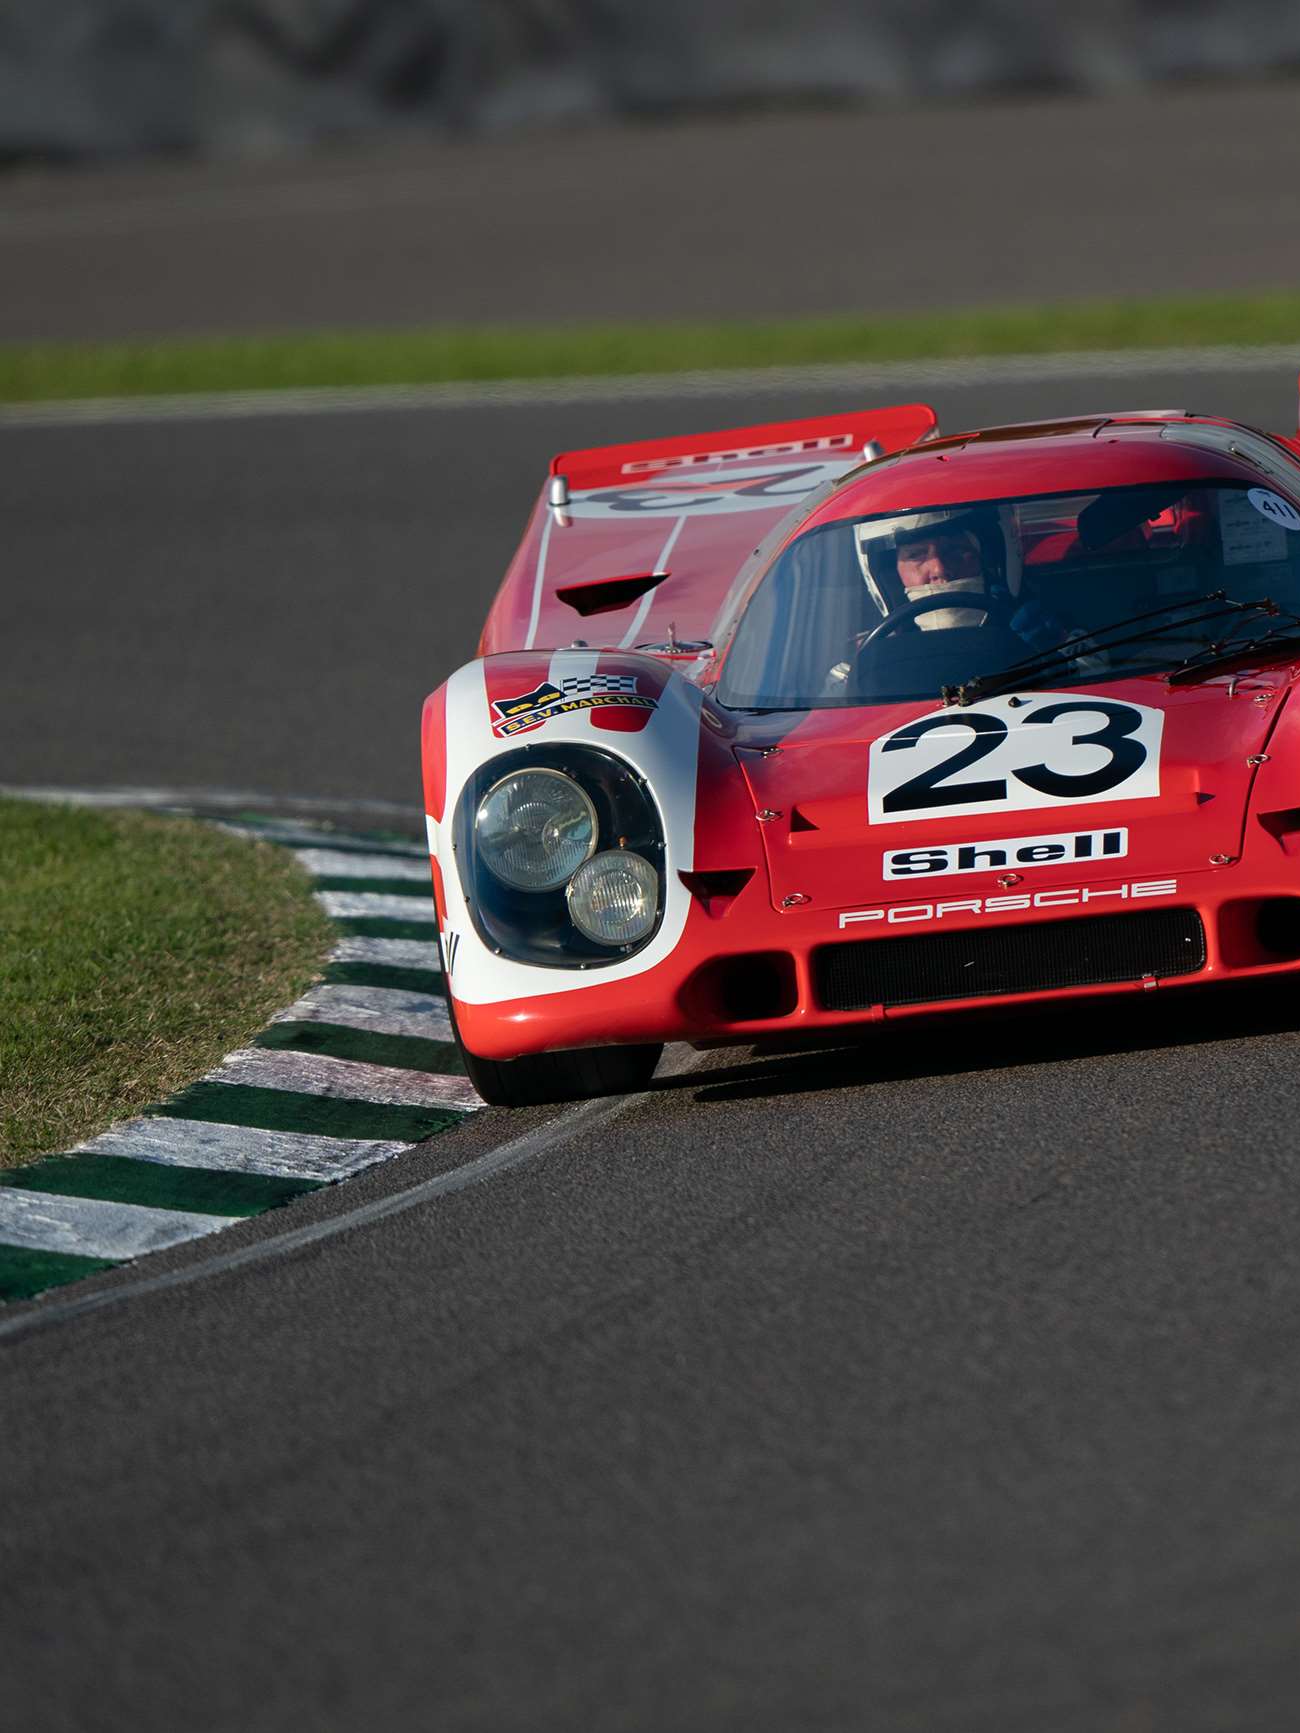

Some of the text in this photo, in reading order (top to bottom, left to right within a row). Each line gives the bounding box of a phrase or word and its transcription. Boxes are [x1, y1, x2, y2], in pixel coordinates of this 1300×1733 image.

[1262, 500, 1297, 519] 411
[505, 695, 656, 732] S.E.V. MARCHAL
[880, 700, 1148, 814] 23
[890, 831, 1121, 876] Shell
[838, 879, 1177, 929] PORSCHE
